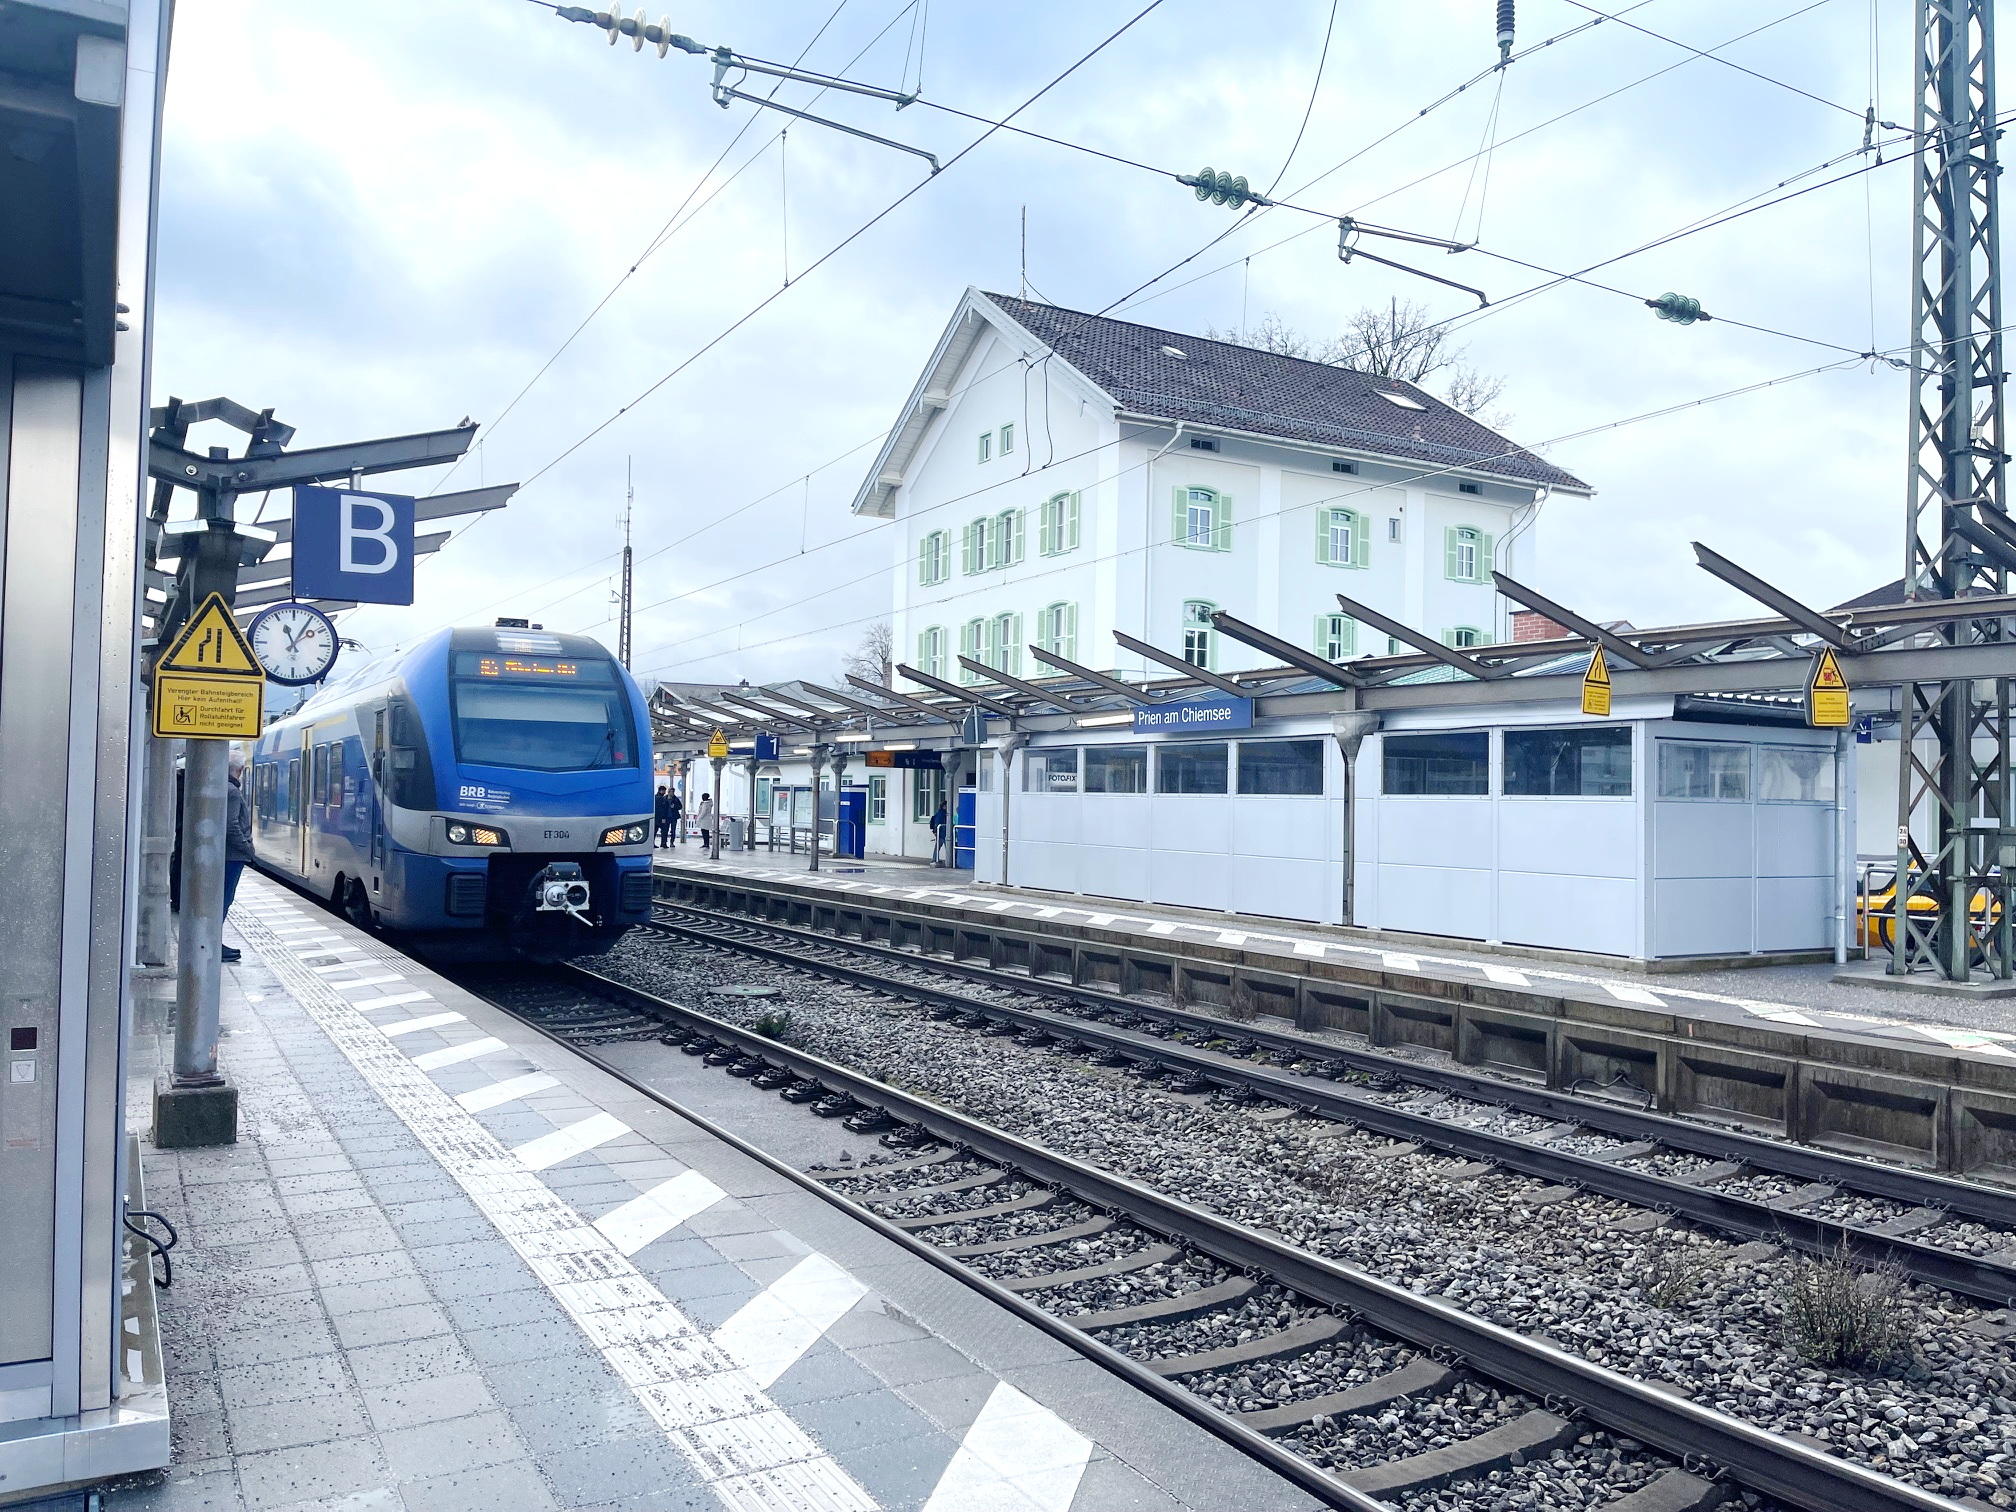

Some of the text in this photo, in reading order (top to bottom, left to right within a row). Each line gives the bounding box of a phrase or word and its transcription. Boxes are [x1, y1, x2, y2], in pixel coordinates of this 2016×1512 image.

[340, 494, 398, 574] B
[167, 687, 254, 698] Verengter Bahnsteigbereich
[200, 713, 246, 721] Rollstuhlfahrer
[1138, 706, 1232, 726] Prien am Chiemsee
[770, 738, 777, 755] 1
[460, 786, 485, 797] BRB
[544, 830, 553, 839] ET
